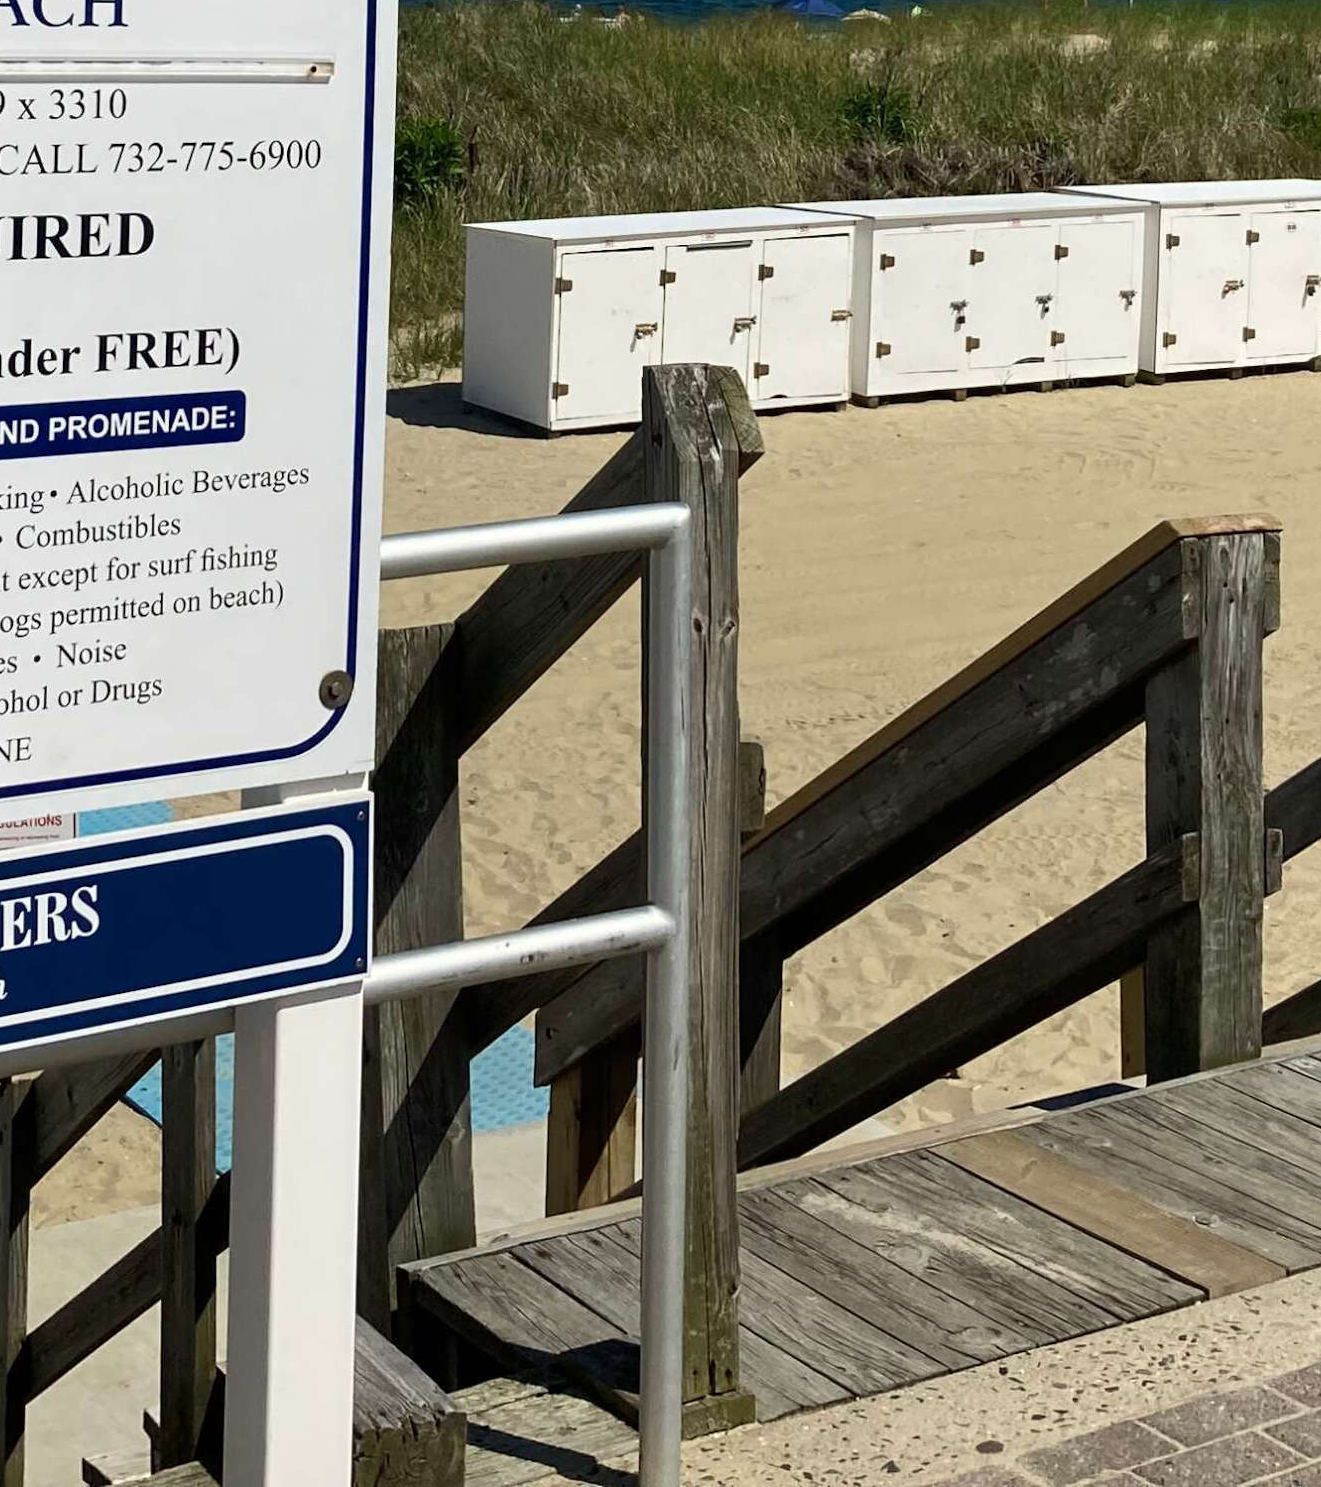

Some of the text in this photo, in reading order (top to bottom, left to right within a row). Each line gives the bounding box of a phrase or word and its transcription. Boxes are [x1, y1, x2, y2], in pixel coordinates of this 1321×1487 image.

[16, 98, 37, 120] x
[48, 88, 127, 120] 3310
[108, 139, 322, 174] 732-775-6900
[94, 326, 240, 375] FREE)
[48, 405, 236, 442] PROMENADE:
[65, 473, 184, 505] Alcoholic
[191, 467, 310, 494] Beverages
[15, 512, 181, 550] Combustibles
[18, 562, 98, 593] except
[106, 556, 142, 582] for
[147, 548, 198, 578] surf
[200, 545, 279, 572] fishing
[49, 591, 165, 636] permitted
[172, 595, 201, 615] on
[209, 579, 284, 611] beach)
[56, 642, 127, 669] Noise
[57, 688, 84, 708] or
[90, 678, 163, 705] Drugs
